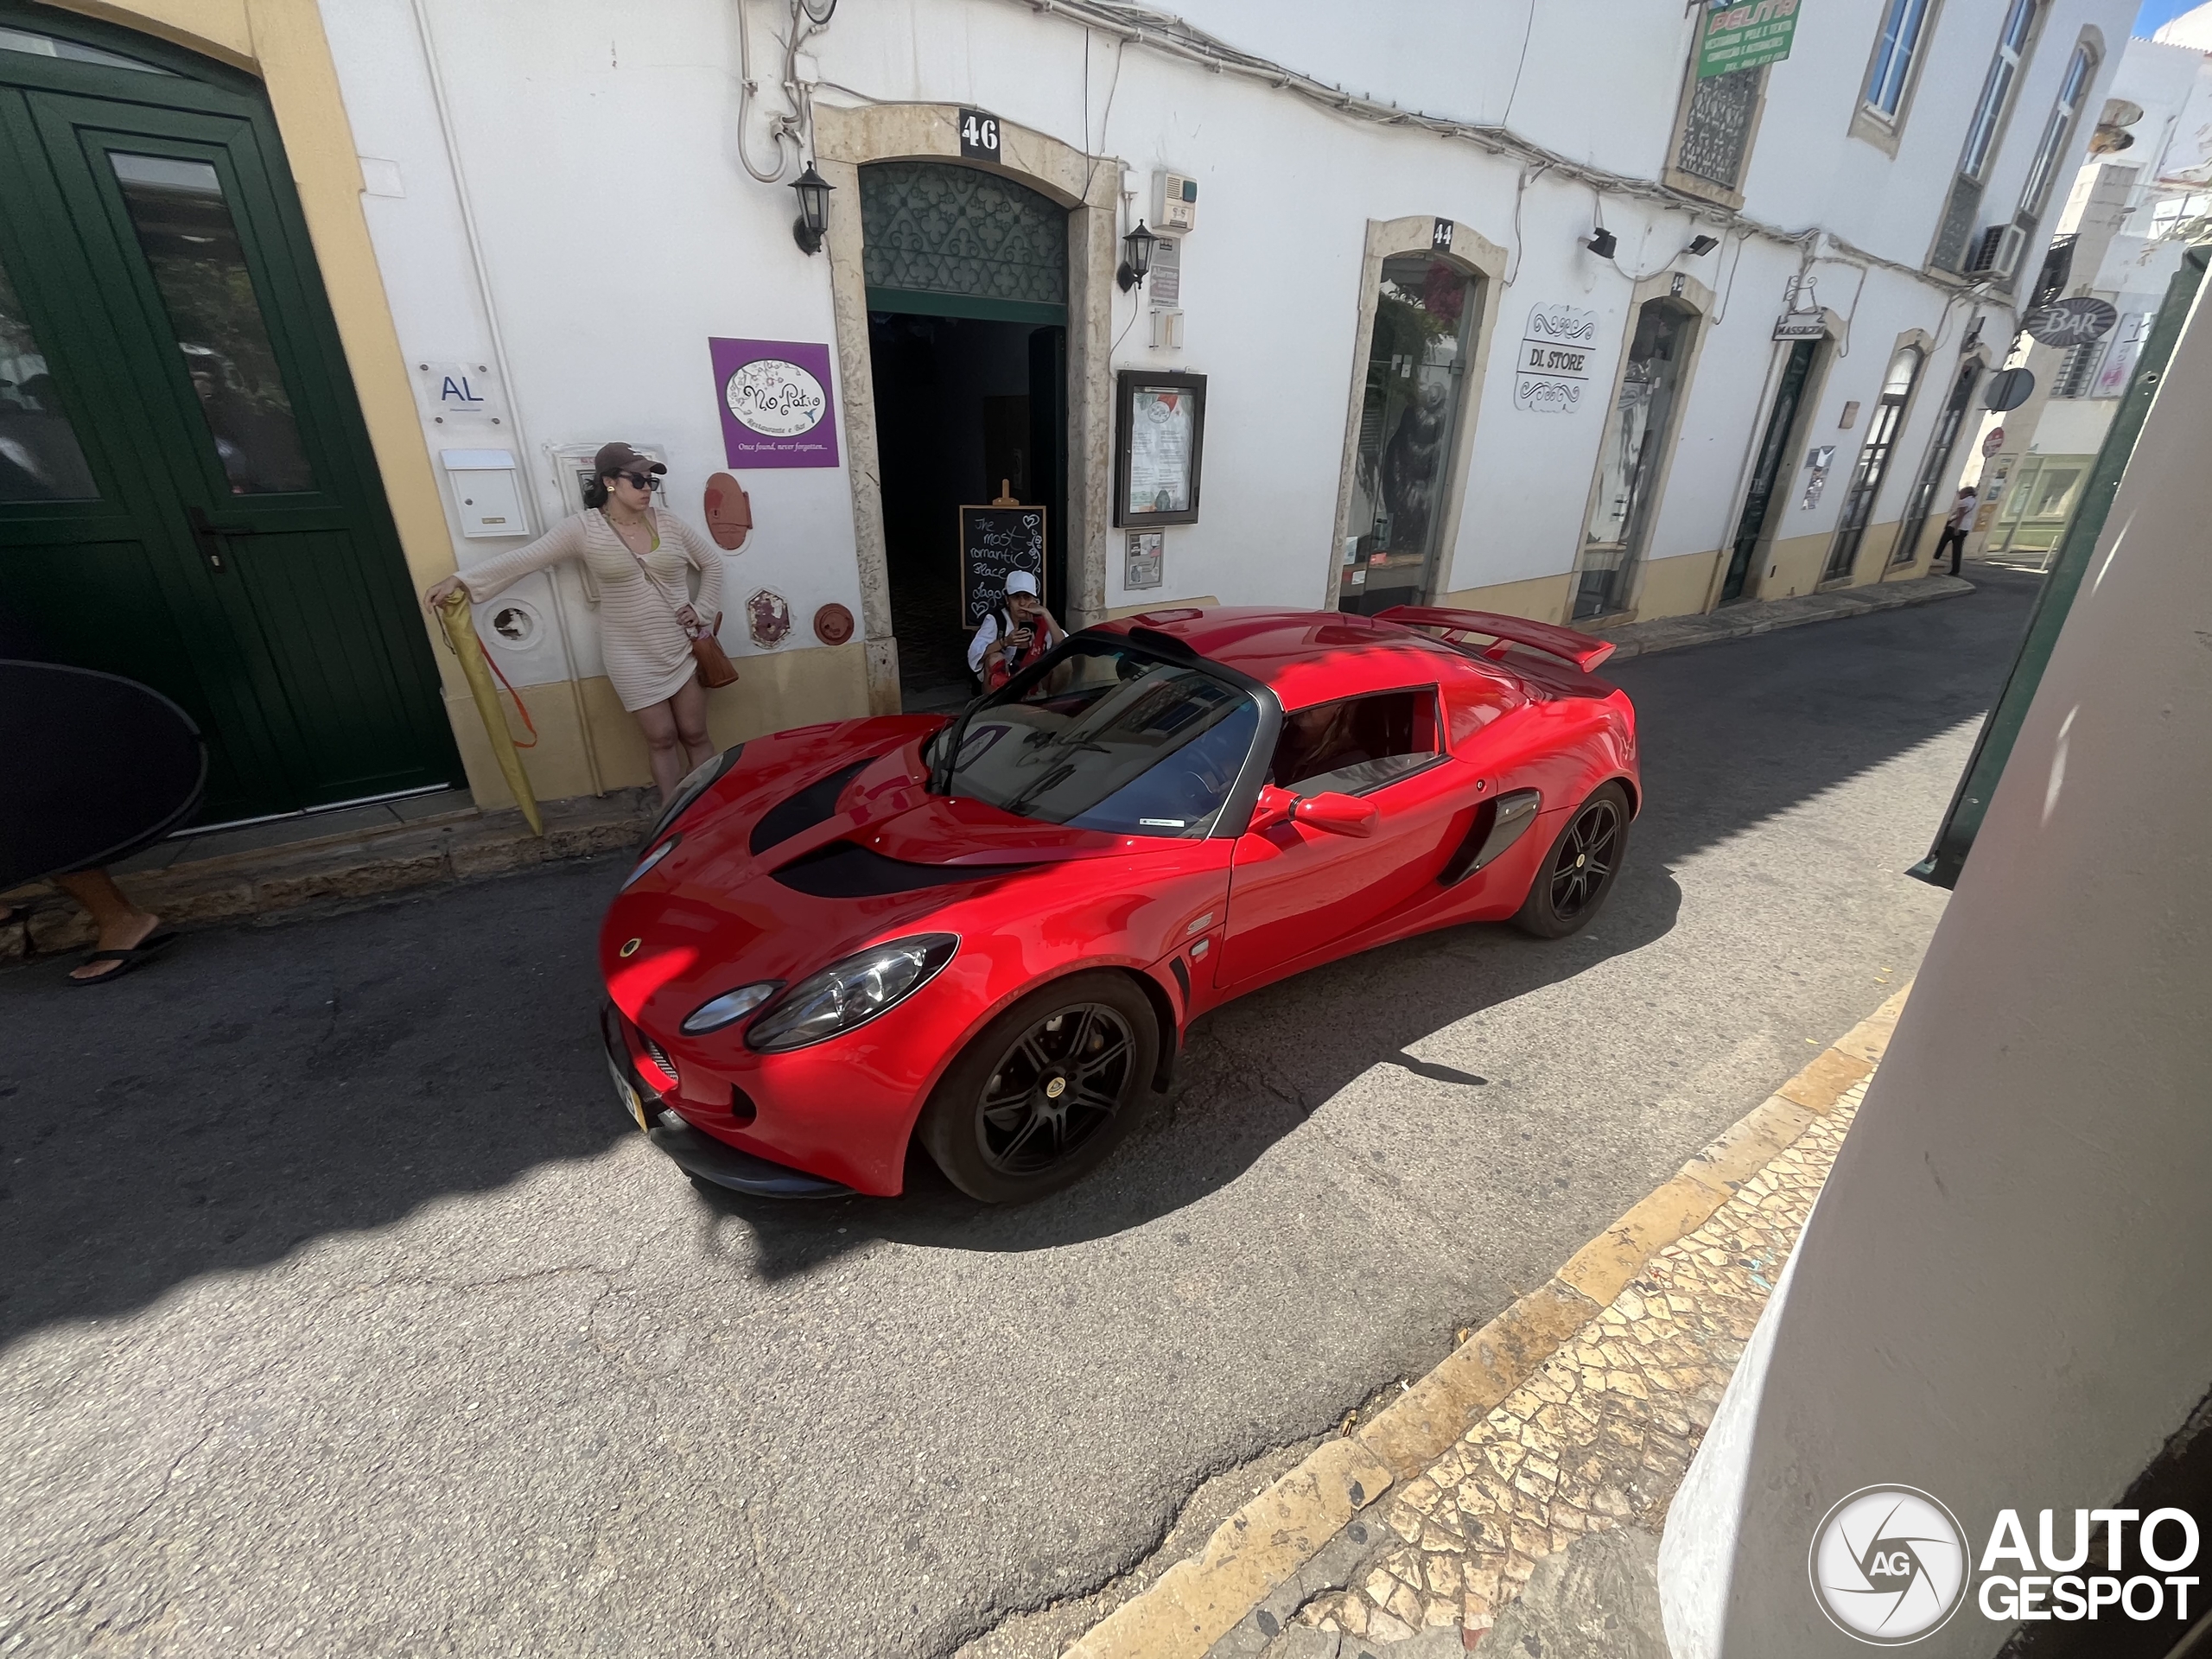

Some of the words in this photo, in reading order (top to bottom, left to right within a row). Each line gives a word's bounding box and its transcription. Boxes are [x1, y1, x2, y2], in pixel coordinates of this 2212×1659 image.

[962, 116, 998, 149] 46
[1434, 224, 1452, 245] 44
[2039, 308, 2099, 335] BAR
[1529, 348, 1545, 367] DL
[1548, 351, 1585, 372] STORE
[442, 376, 484, 401] AL
[743, 385, 778, 411] No
[747, 417, 785, 433] Restaurante
[983, 525, 1026, 550] most
[969, 548, 1034, 569] romantic
